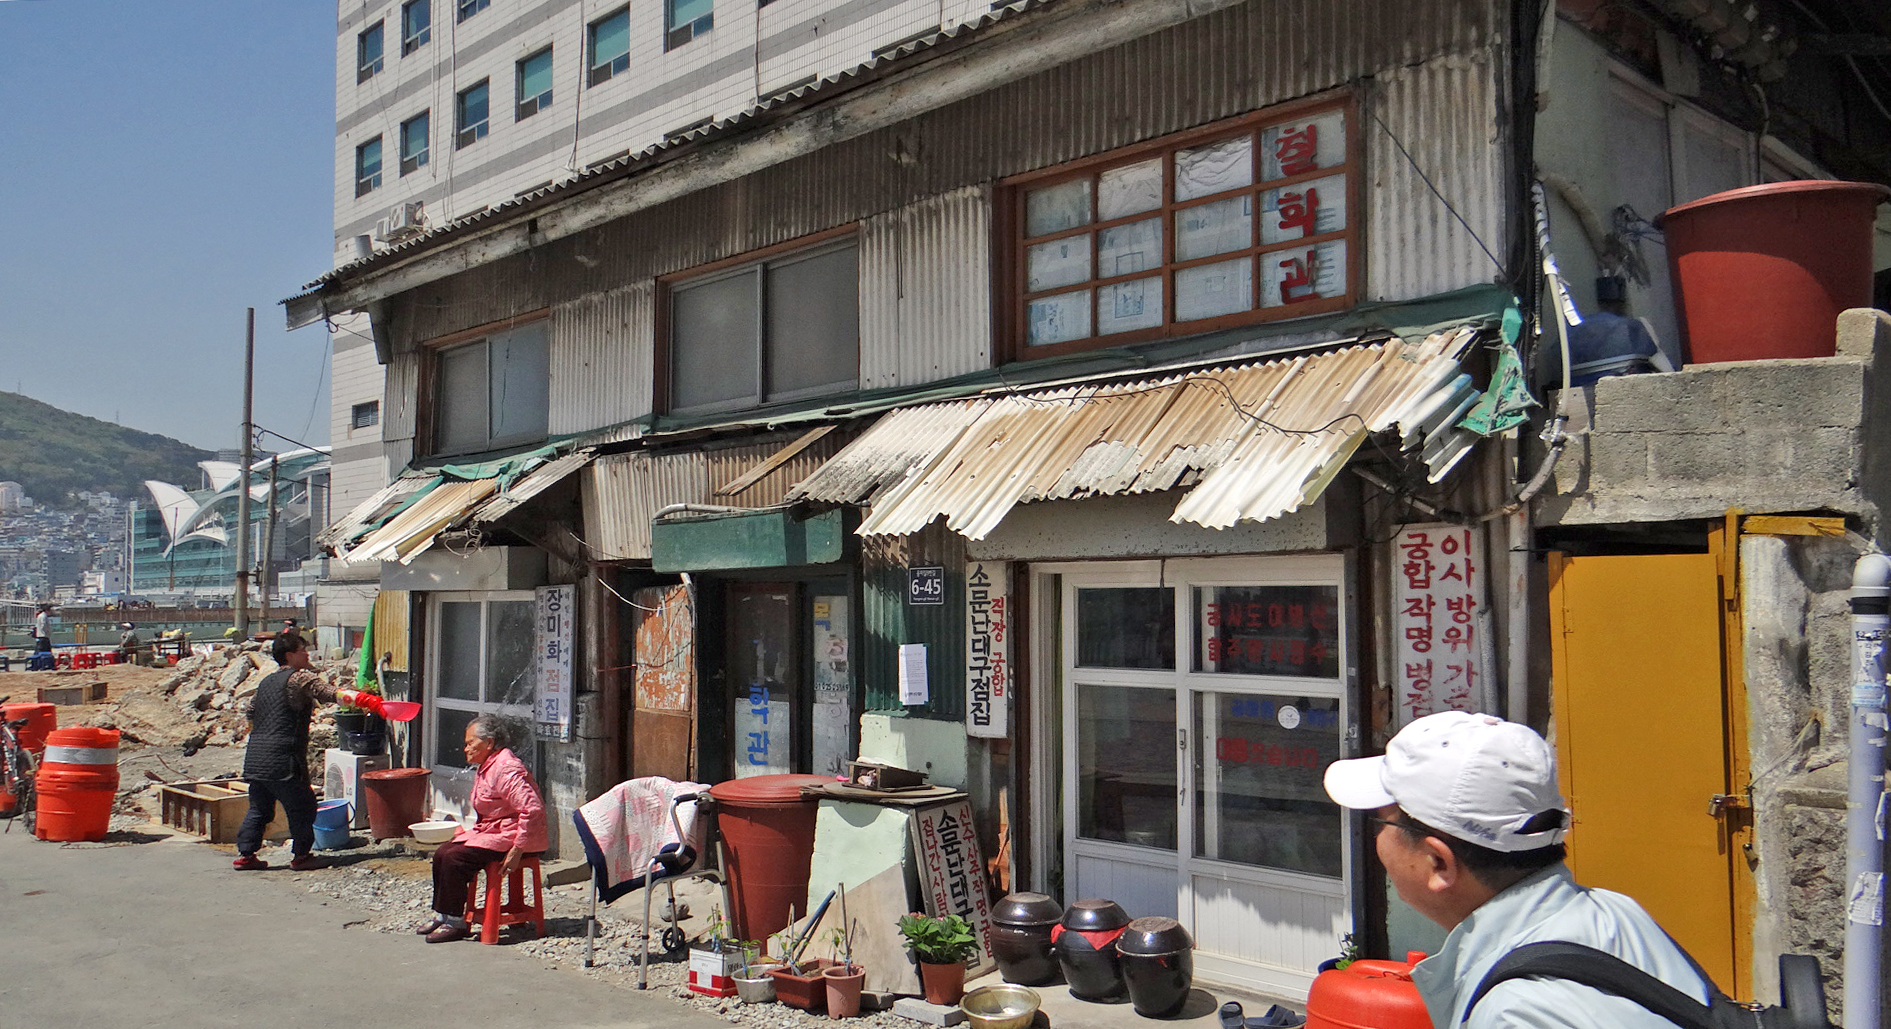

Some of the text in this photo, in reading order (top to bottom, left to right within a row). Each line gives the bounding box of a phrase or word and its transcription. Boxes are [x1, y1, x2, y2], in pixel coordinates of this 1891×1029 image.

[911, 578, 941, 595] 6-45
[1400, 532, 1436, 590] 궁합
[1438, 529, 1475, 589] 이사
[989, 596, 1006, 697] 직장 궁합
[1401, 593, 1436, 653] 작명
[1441, 593, 1477, 654] 방위
